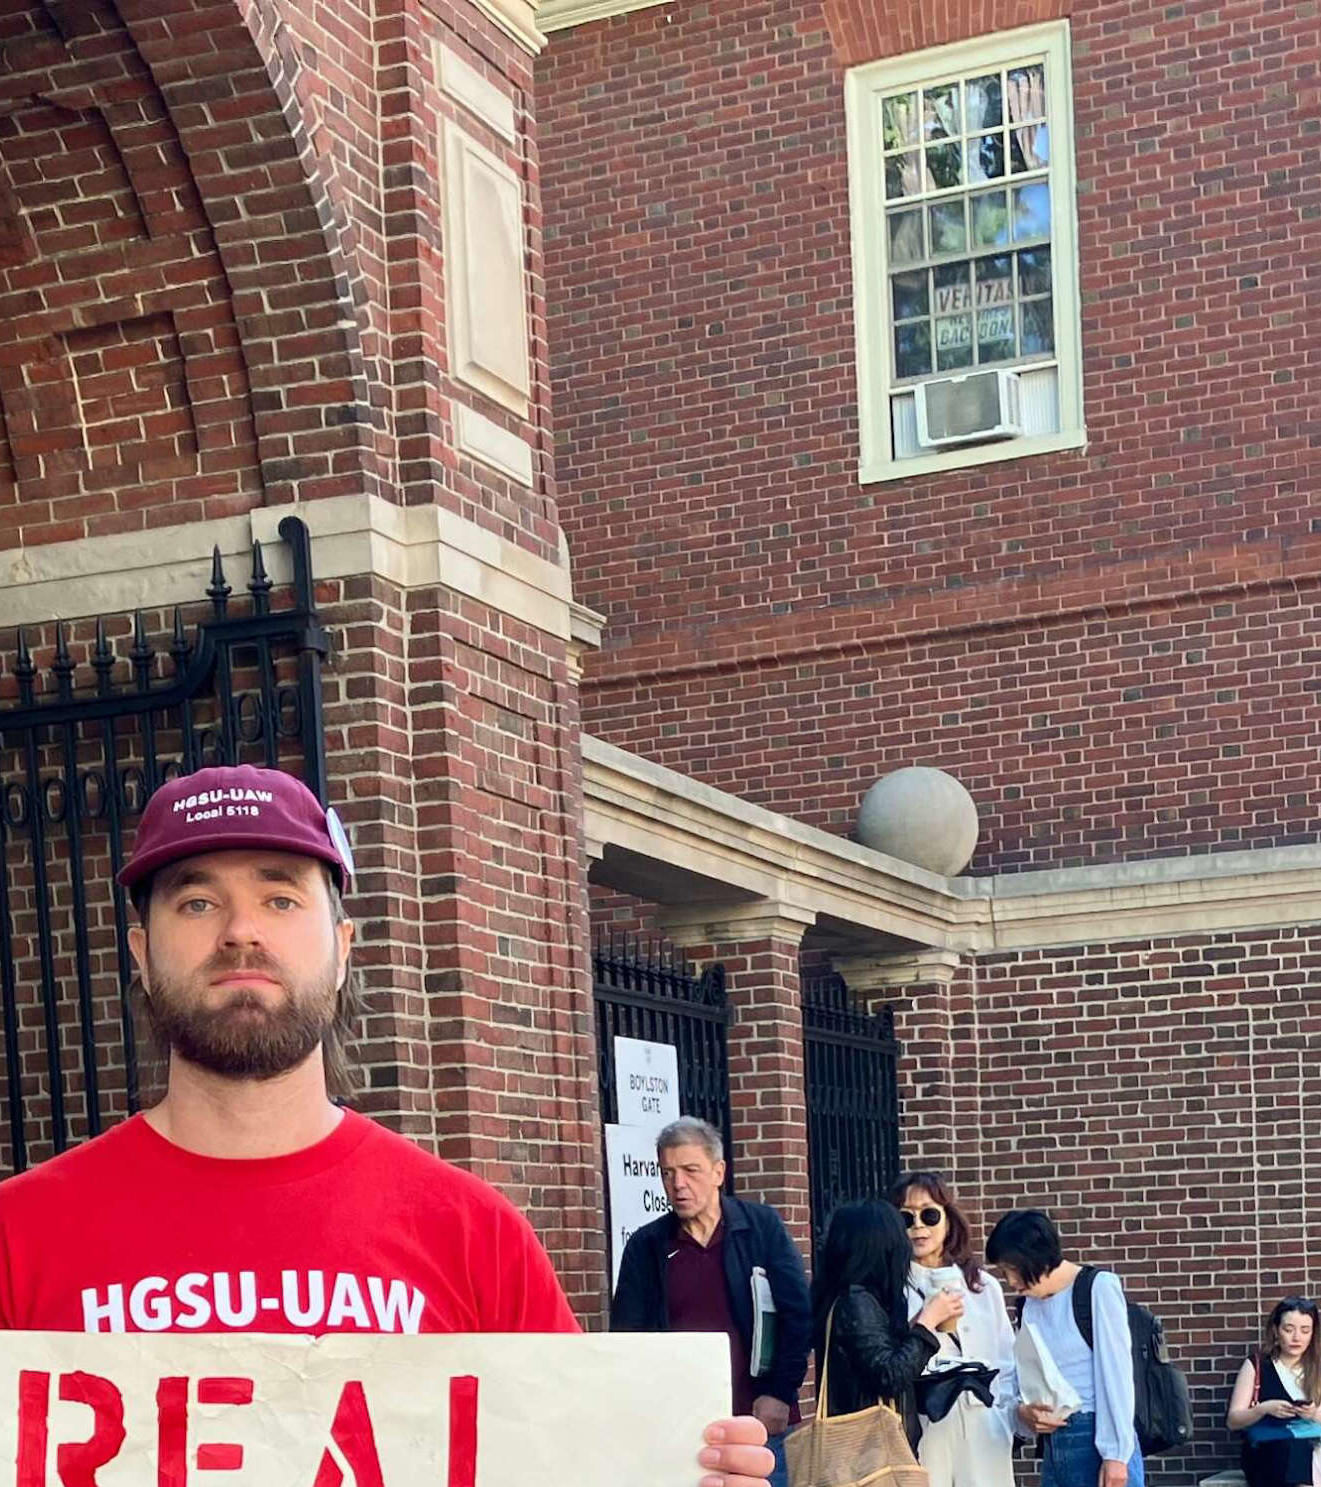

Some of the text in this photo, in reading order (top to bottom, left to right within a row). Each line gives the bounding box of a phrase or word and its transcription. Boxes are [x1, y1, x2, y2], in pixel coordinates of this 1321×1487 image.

[173, 788, 272, 812] HGSU-UAW
[186, 805, 259, 822] Local 5118
[630, 1073, 669, 1095] BOYLSTON
[641, 1096, 661, 1114] GATE
[622, 1153, 661, 1177] Harvar
[643, 1189, 672, 1213] Close
[81, 1269, 426, 1335] HGSU-UAW
